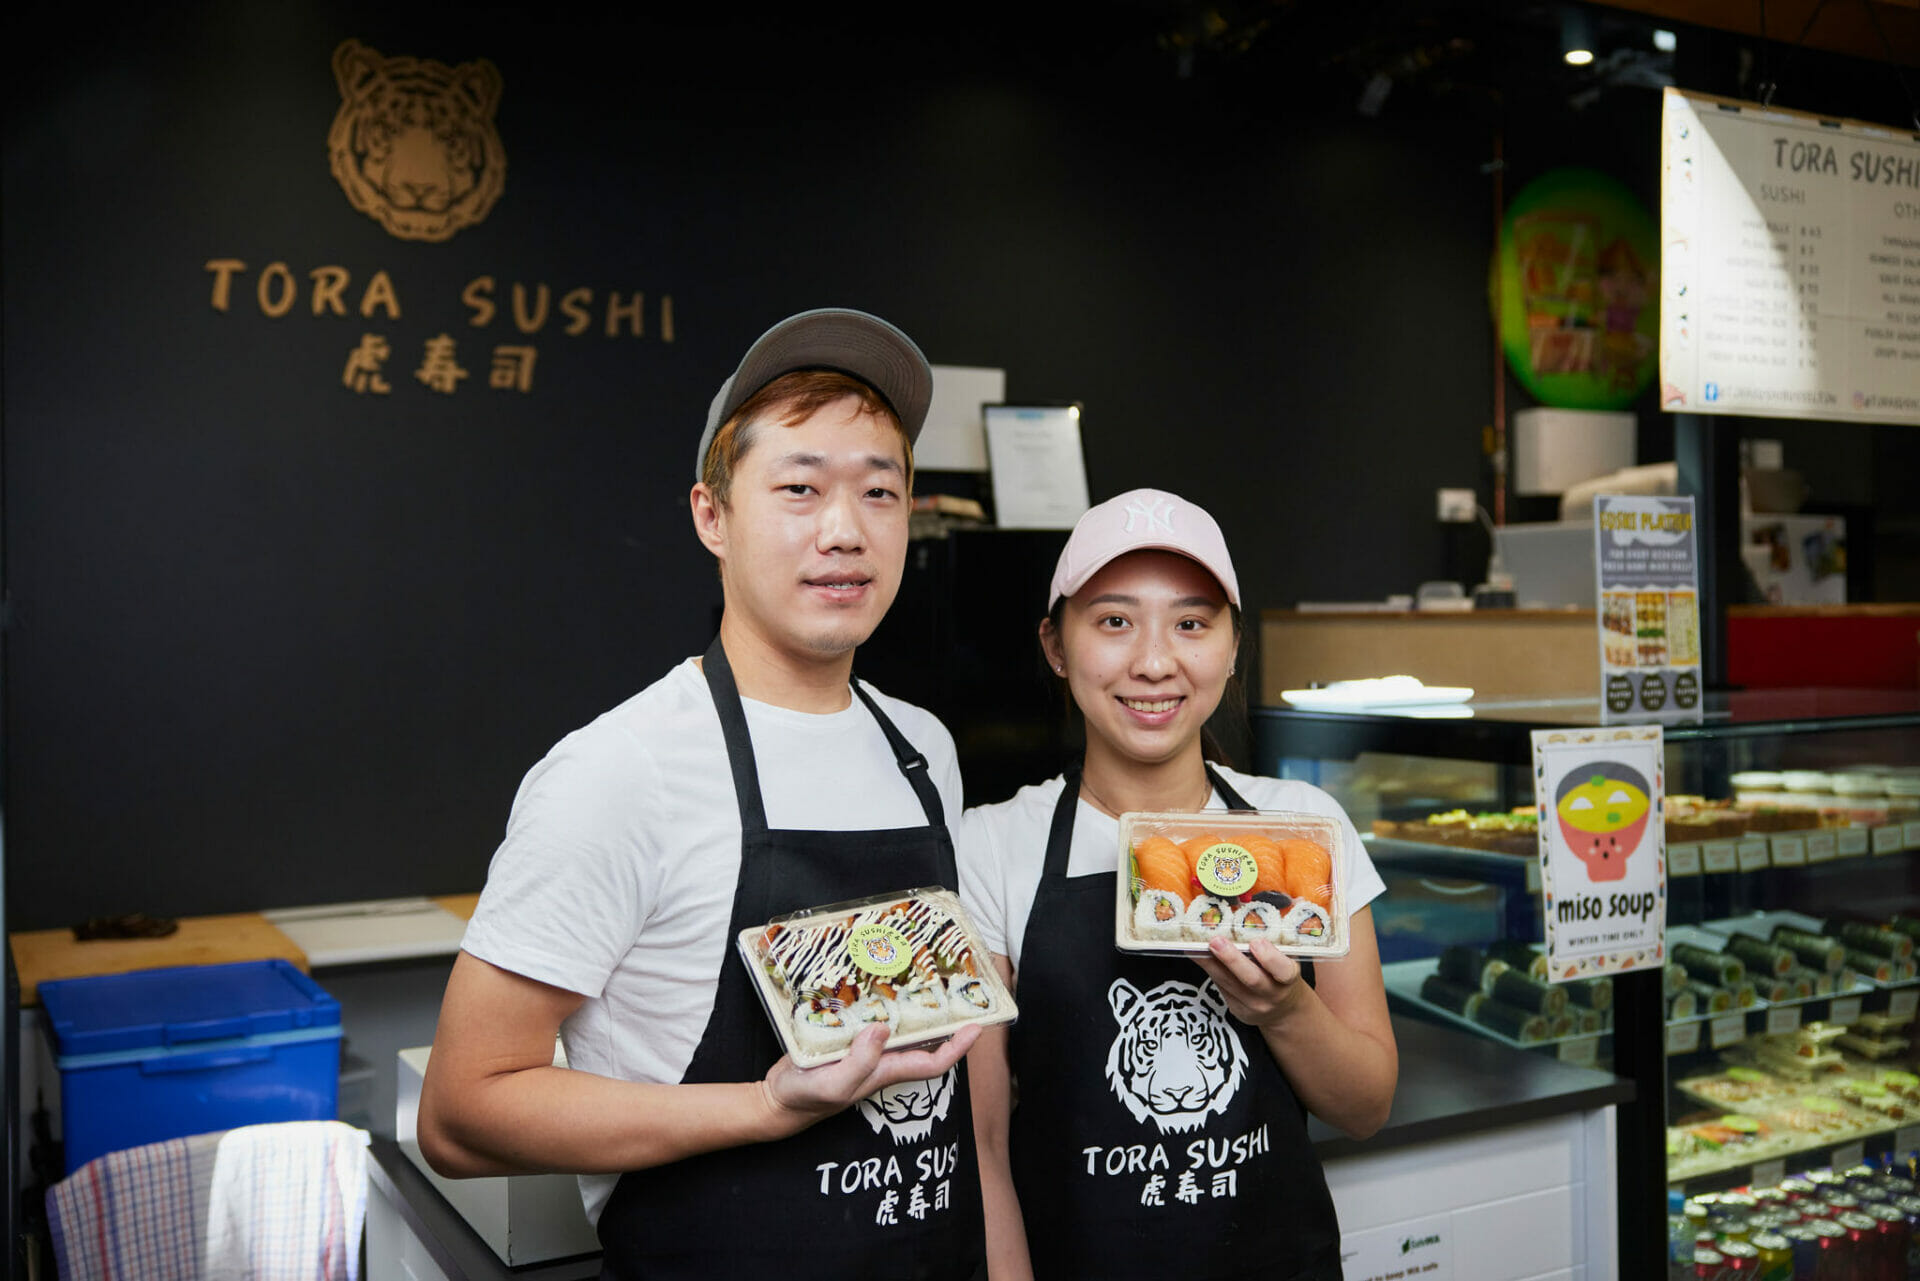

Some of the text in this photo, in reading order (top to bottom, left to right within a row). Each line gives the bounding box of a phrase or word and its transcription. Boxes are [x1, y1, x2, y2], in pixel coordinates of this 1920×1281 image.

[1773, 137, 1920, 189] TORA SUSHI
[1760, 183, 1806, 204] SUSHI
[205, 258, 674, 342] TORA SUSHI
[342, 333, 538, 394] 虎寿司
[1216, 847, 1243, 856] SUSHI
[1558, 892, 1655, 923] miso soup
[860, 927, 886, 937] SUSHI
[1569, 929, 1644, 946] WINTER TIME ONLY
[815, 1141, 959, 1196] TORA SUS
[1082, 1123, 1270, 1177] TORA SUSHI
[875, 1180, 950, 1227] 虎寿司
[1140, 1168, 1238, 1207] 虎寿司
